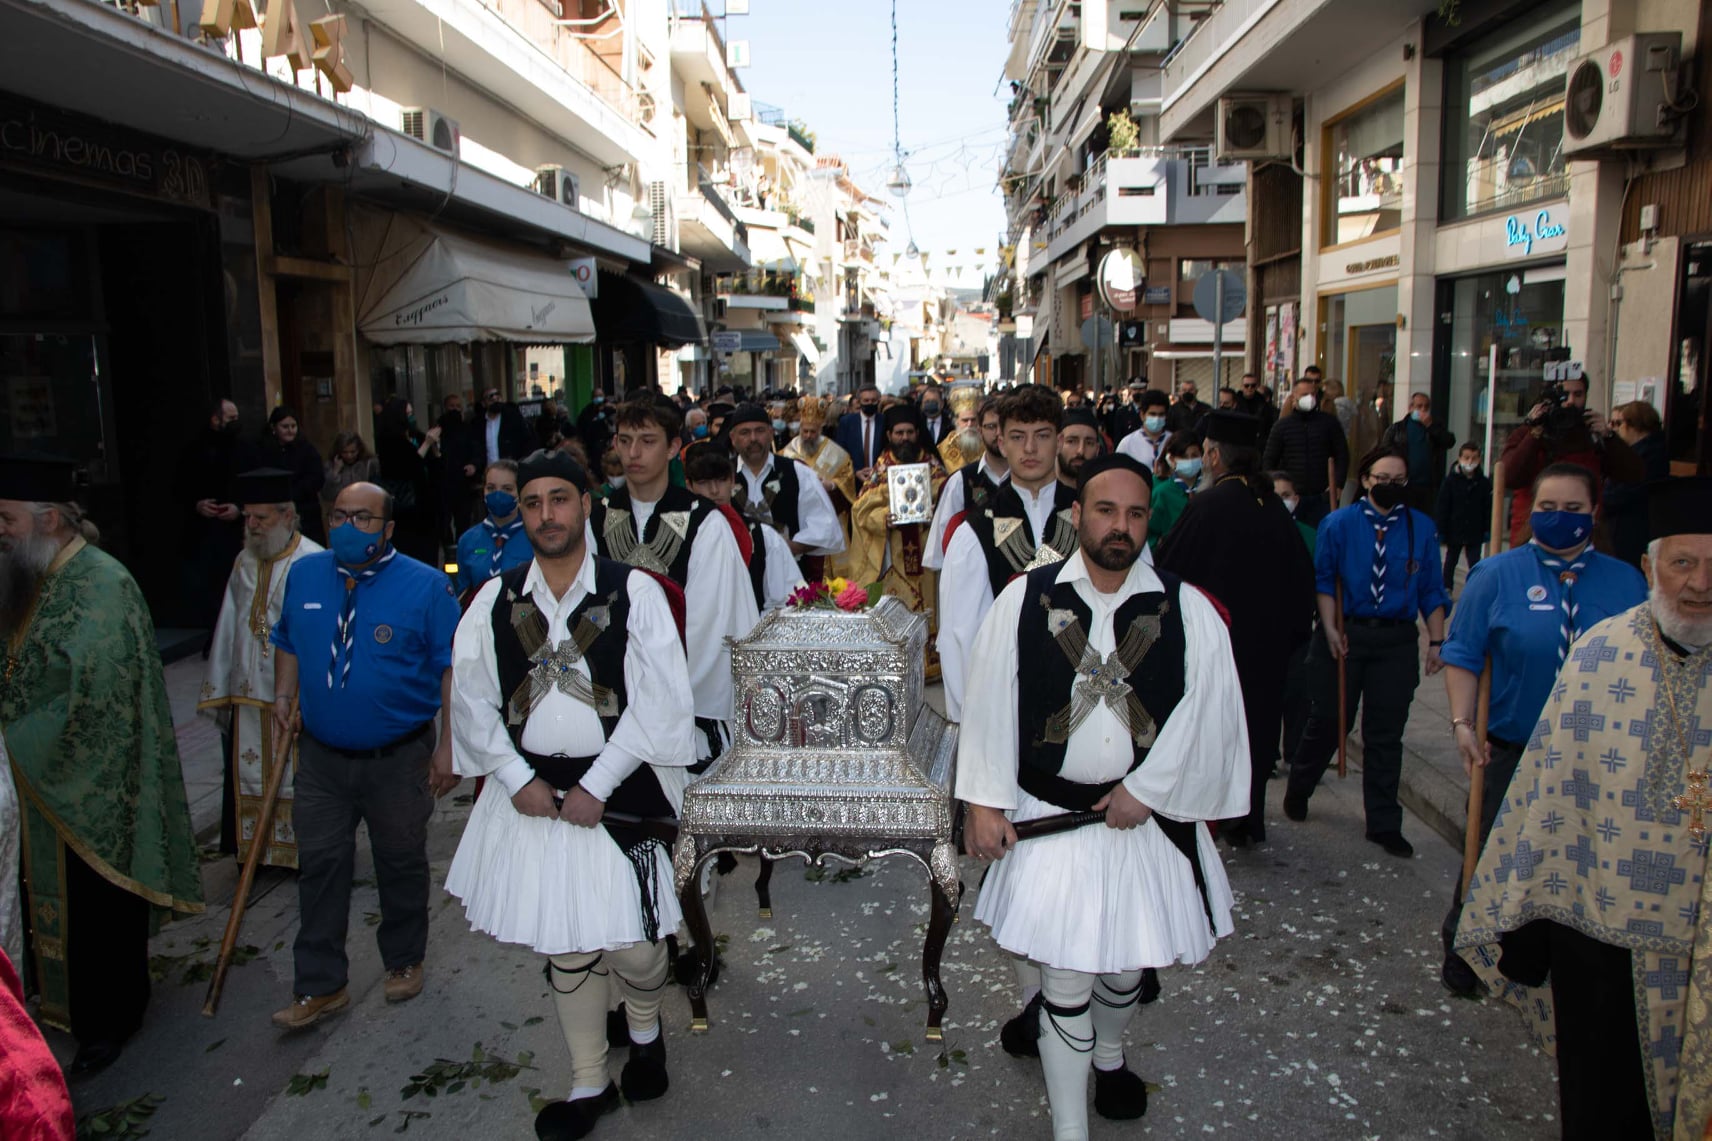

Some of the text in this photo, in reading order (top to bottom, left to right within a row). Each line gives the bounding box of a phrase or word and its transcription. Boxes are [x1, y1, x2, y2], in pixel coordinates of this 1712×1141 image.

[1, 110, 208, 199] cinemas 3D
[1506, 215, 1533, 256] Baby
